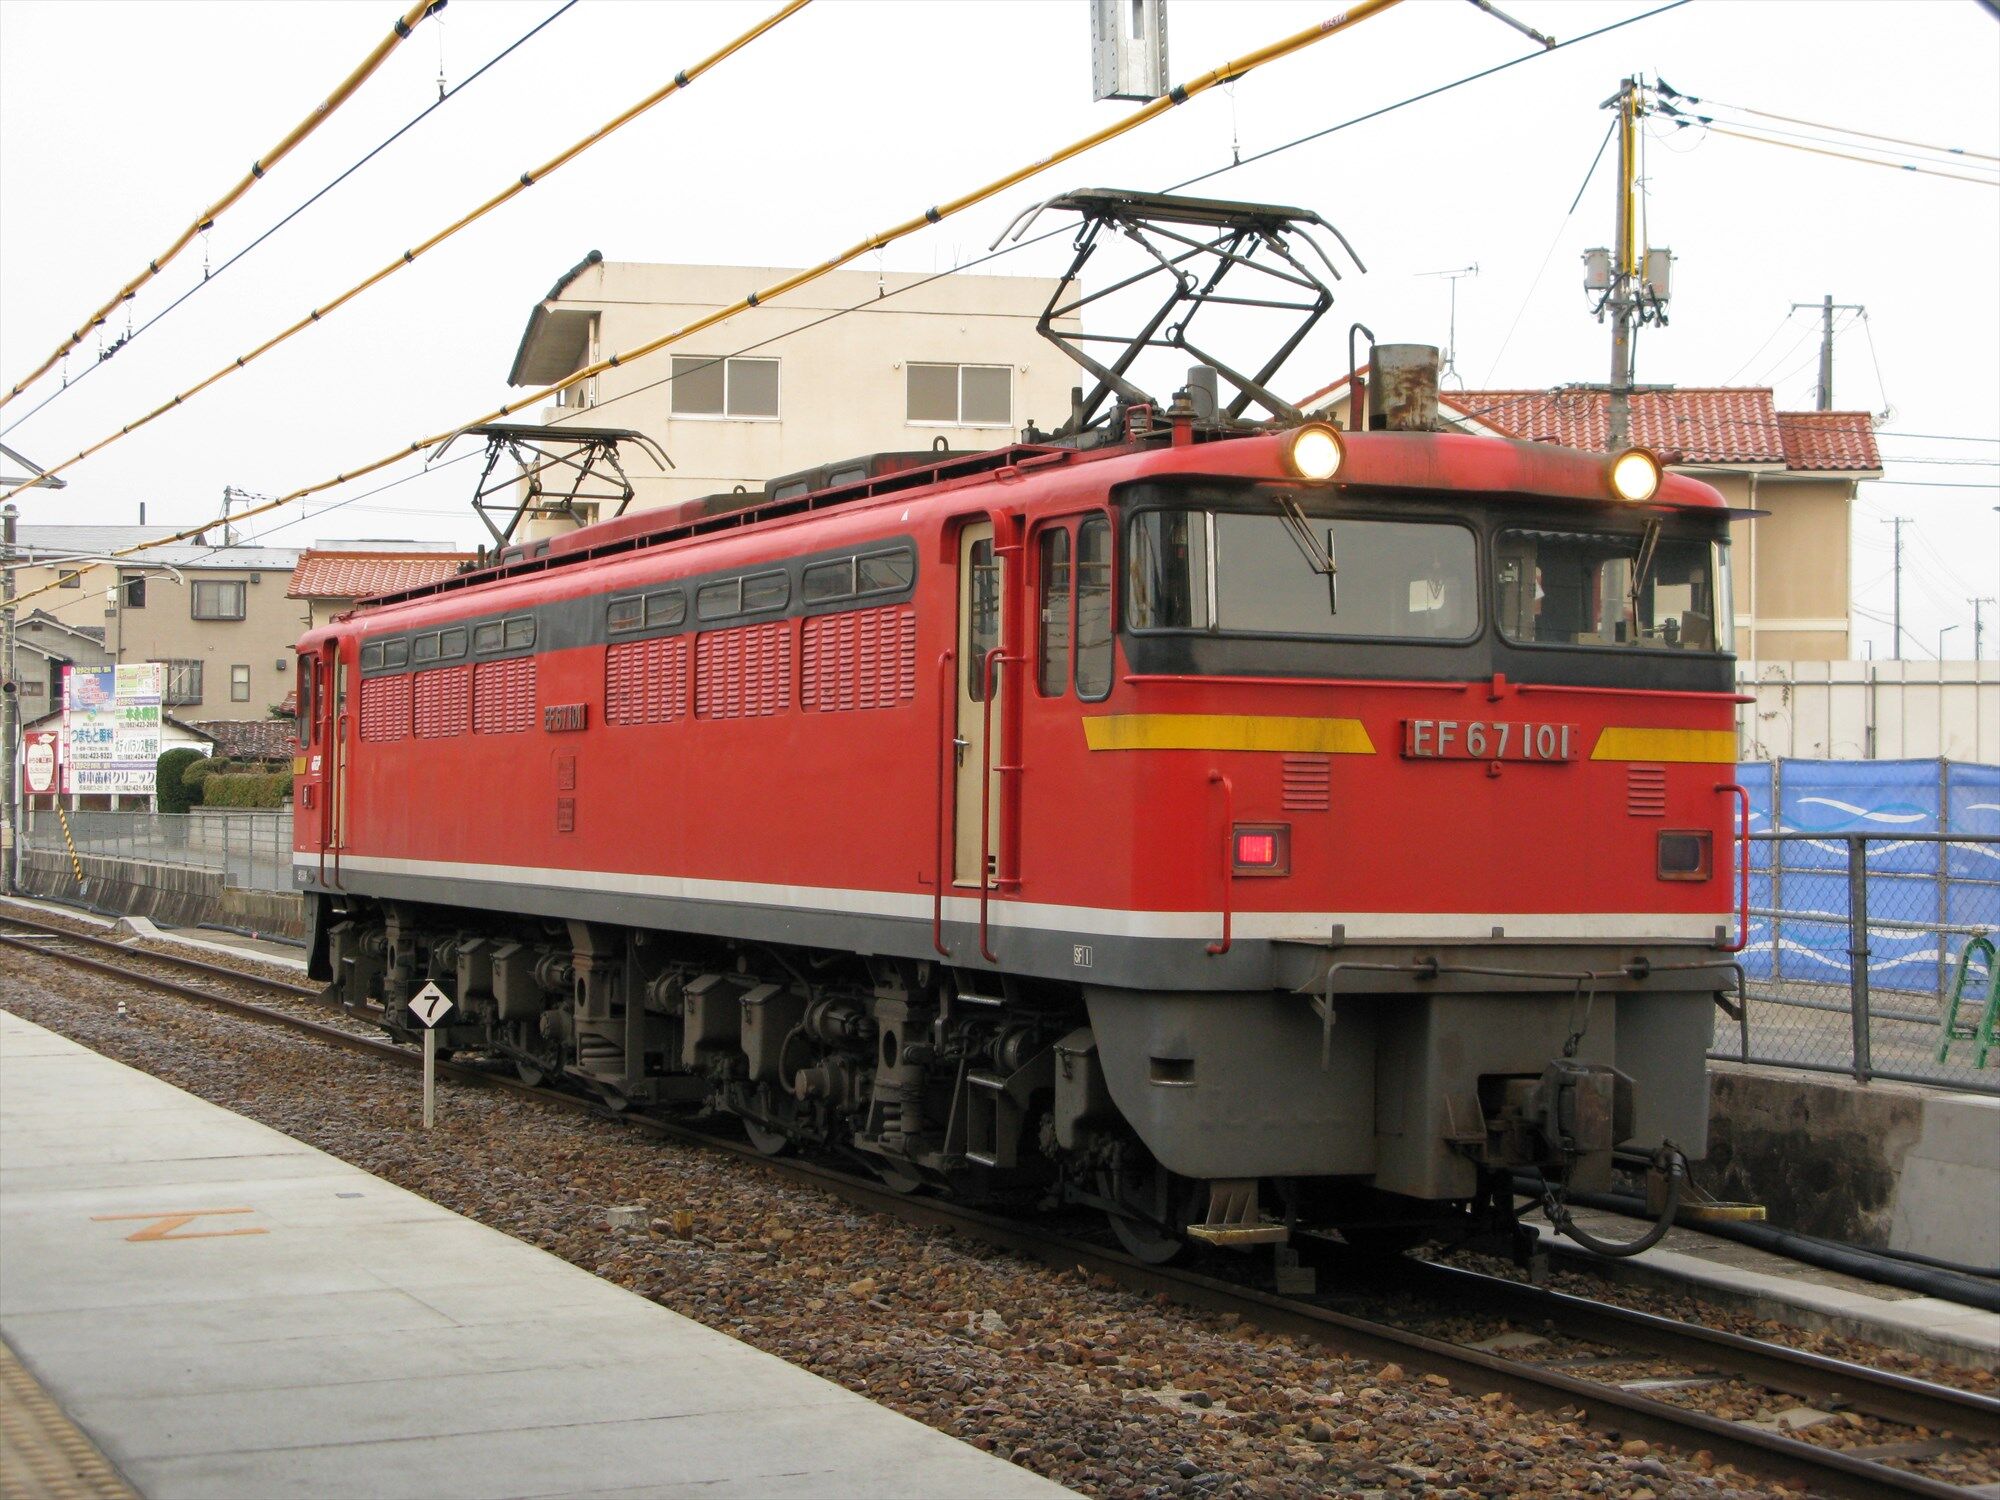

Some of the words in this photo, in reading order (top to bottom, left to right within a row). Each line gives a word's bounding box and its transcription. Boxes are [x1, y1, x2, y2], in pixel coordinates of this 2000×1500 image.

[71, 728, 113, 743] つまもと眼科
[1524, 724, 1568, 759] 101
[424, 996, 440, 1018] 7
